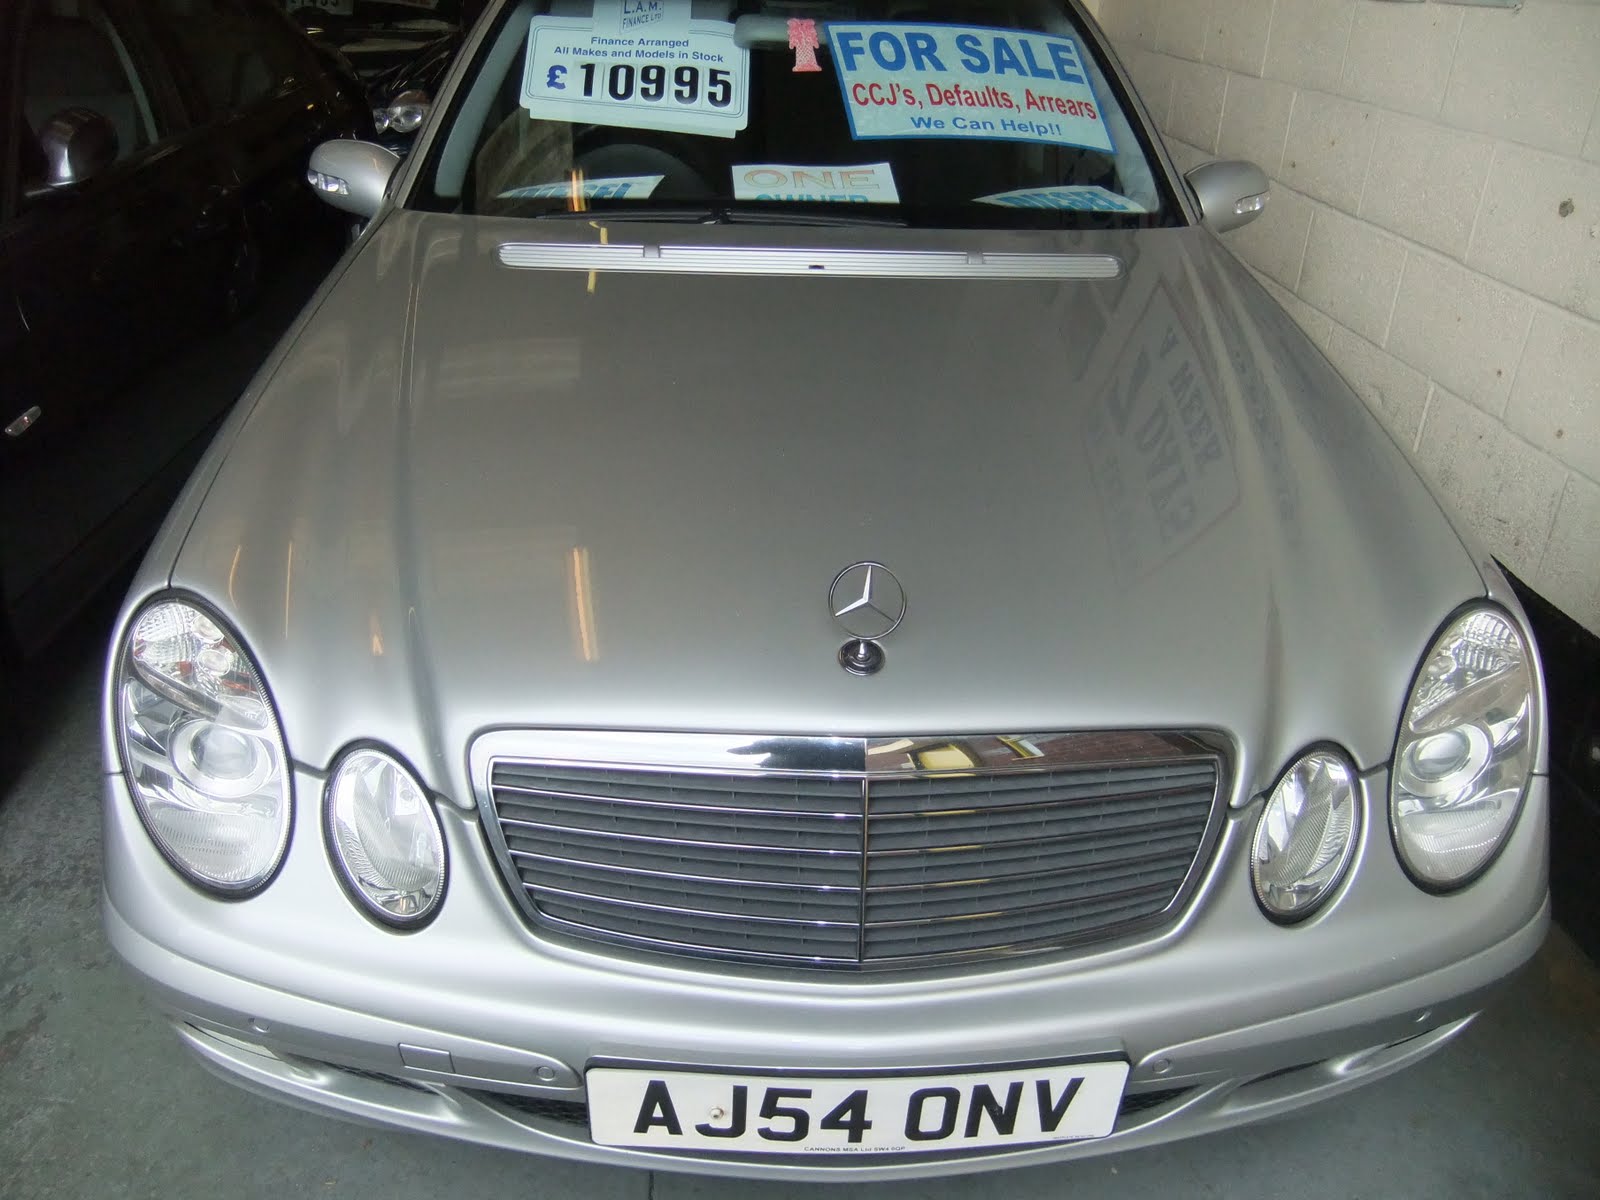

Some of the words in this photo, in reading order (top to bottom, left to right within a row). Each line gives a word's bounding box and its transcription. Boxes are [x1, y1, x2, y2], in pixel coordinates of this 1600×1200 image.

[623, 14, 649, 29] FINANCE
[591, 37, 634, 46] Finance
[638, 38, 689, 48] Arranged
[554, 46, 569, 54] All
[573, 47, 608, 57] Makes
[611, 49, 631, 58] and
[635, 50, 675, 59] Models
[678, 51, 688, 59] in
[691, 52, 724, 62] Stock
[836, 31, 947, 73] FOR
[954, 33, 1085, 85] SALE
[852, 83, 924, 109] CCJ's,
[925, 83, 1022, 113] Defaults,
[1025, 88, 1097, 120] Arrears
[910, 116, 945, 129] We
[952, 116, 995, 131] Can
[1000, 118, 1062, 136] Help!!
[744, 169, 880, 189] ONE
[633, 1079, 872, 1143] AJ54
[904, 1077, 1085, 1140] ONV
